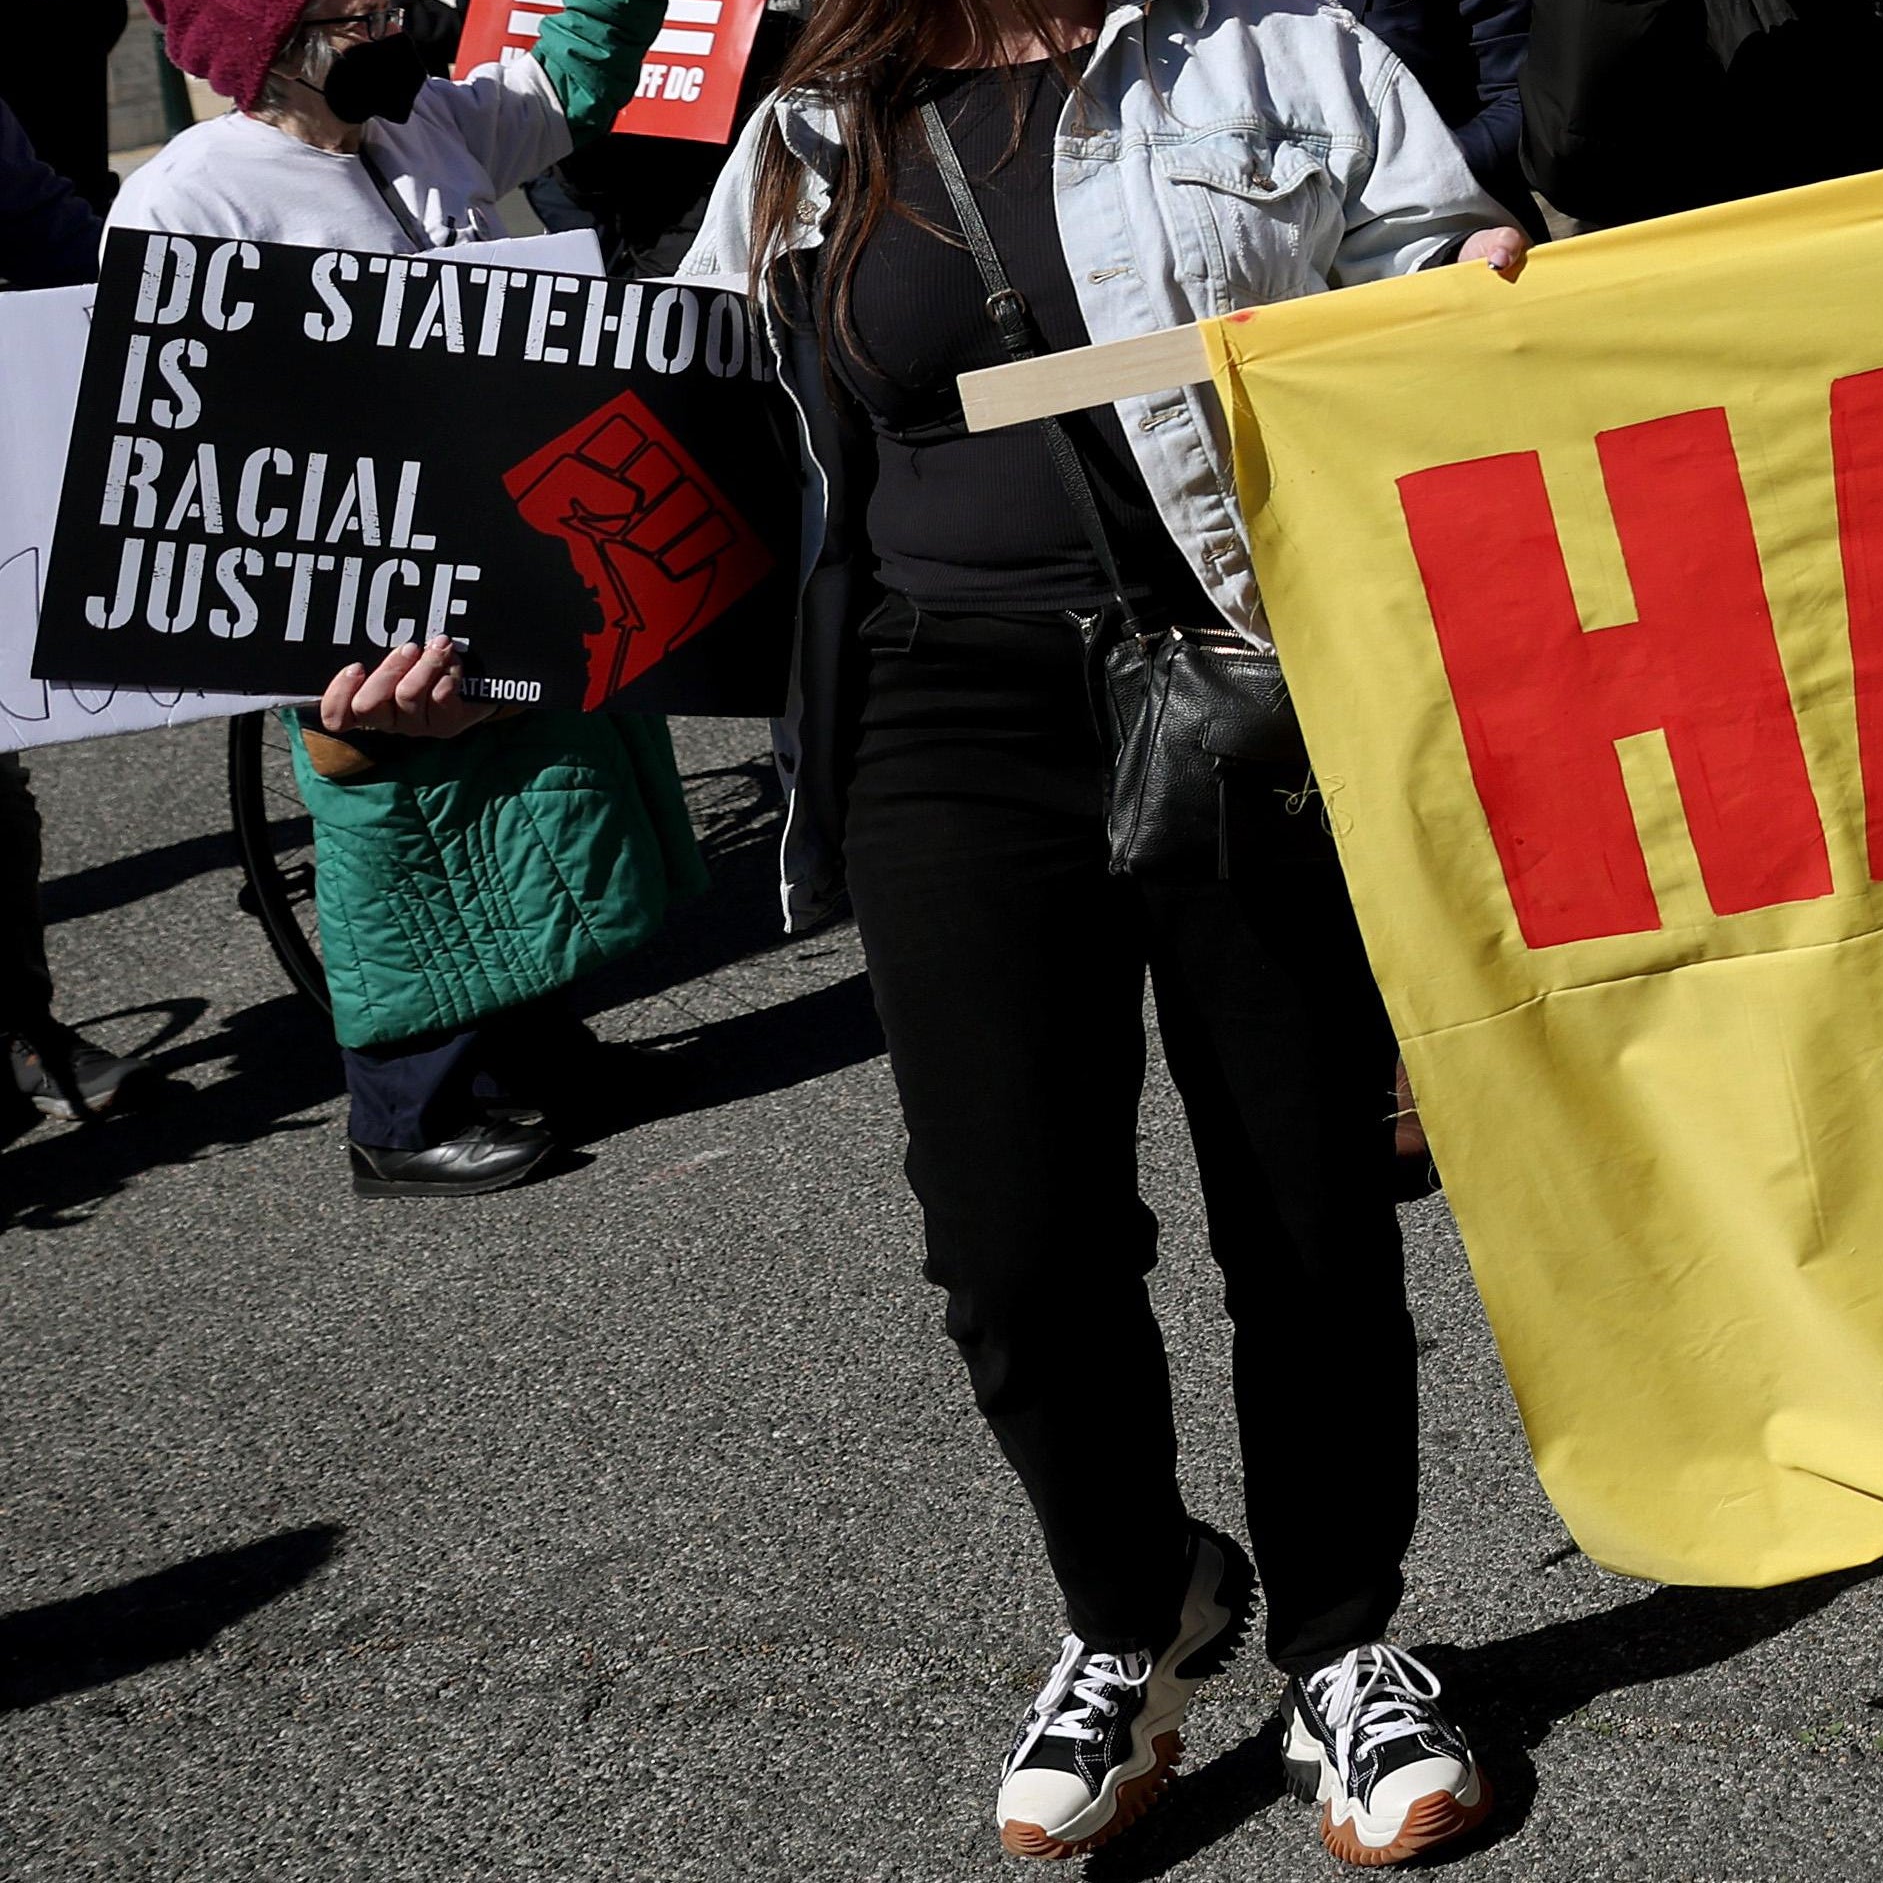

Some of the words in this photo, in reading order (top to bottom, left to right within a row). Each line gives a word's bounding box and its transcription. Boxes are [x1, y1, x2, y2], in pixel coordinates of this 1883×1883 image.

[634, 63, 668, 98] FF
[663, 66, 704, 102] DC
[134, 235, 261, 331] DC
[116, 335, 208, 429] IS
[100, 435, 436, 550] RACIAL
[86, 537, 481, 652] JUSTICE
